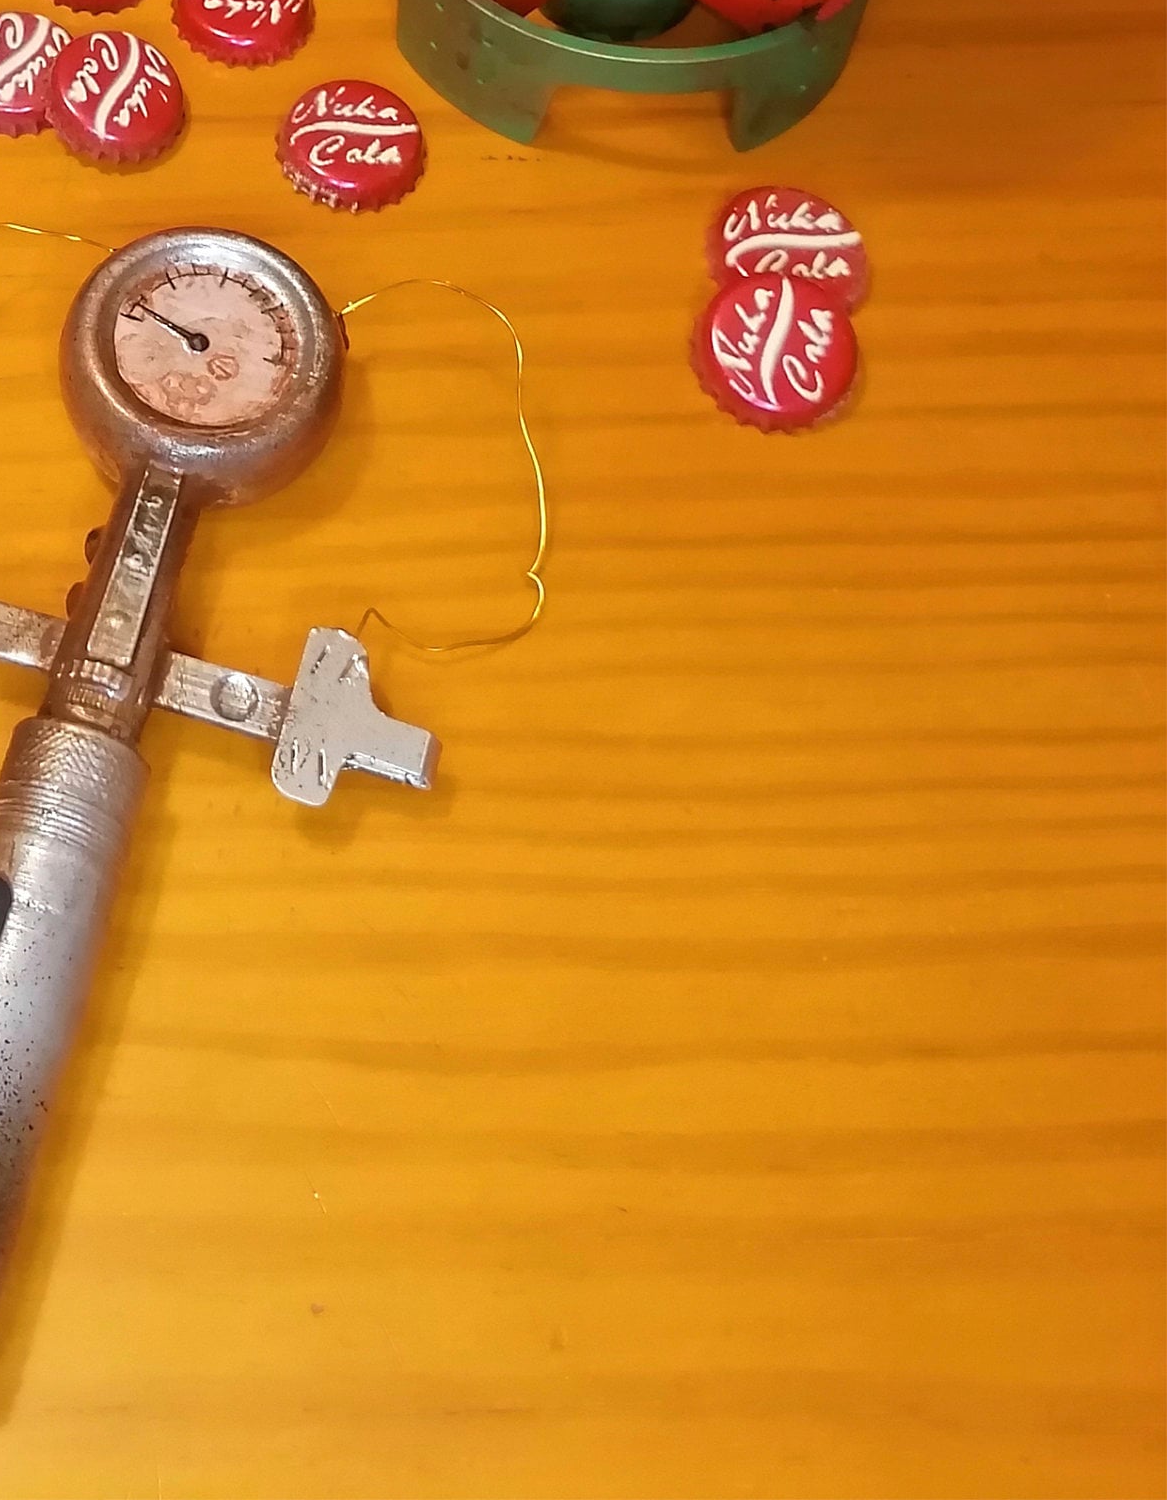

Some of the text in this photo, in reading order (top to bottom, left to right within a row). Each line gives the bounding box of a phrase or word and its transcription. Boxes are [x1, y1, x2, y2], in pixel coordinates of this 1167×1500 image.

[67, 32, 120, 103] Cola
[113, 44, 171, 128] Nuka
[291, 86, 399, 124] Nuka
[309, 135, 402, 166] Cola
[723, 193, 845, 241] Nuka
[712, 288, 776, 400] Nuka
[782, 308, 833, 403] Cola
